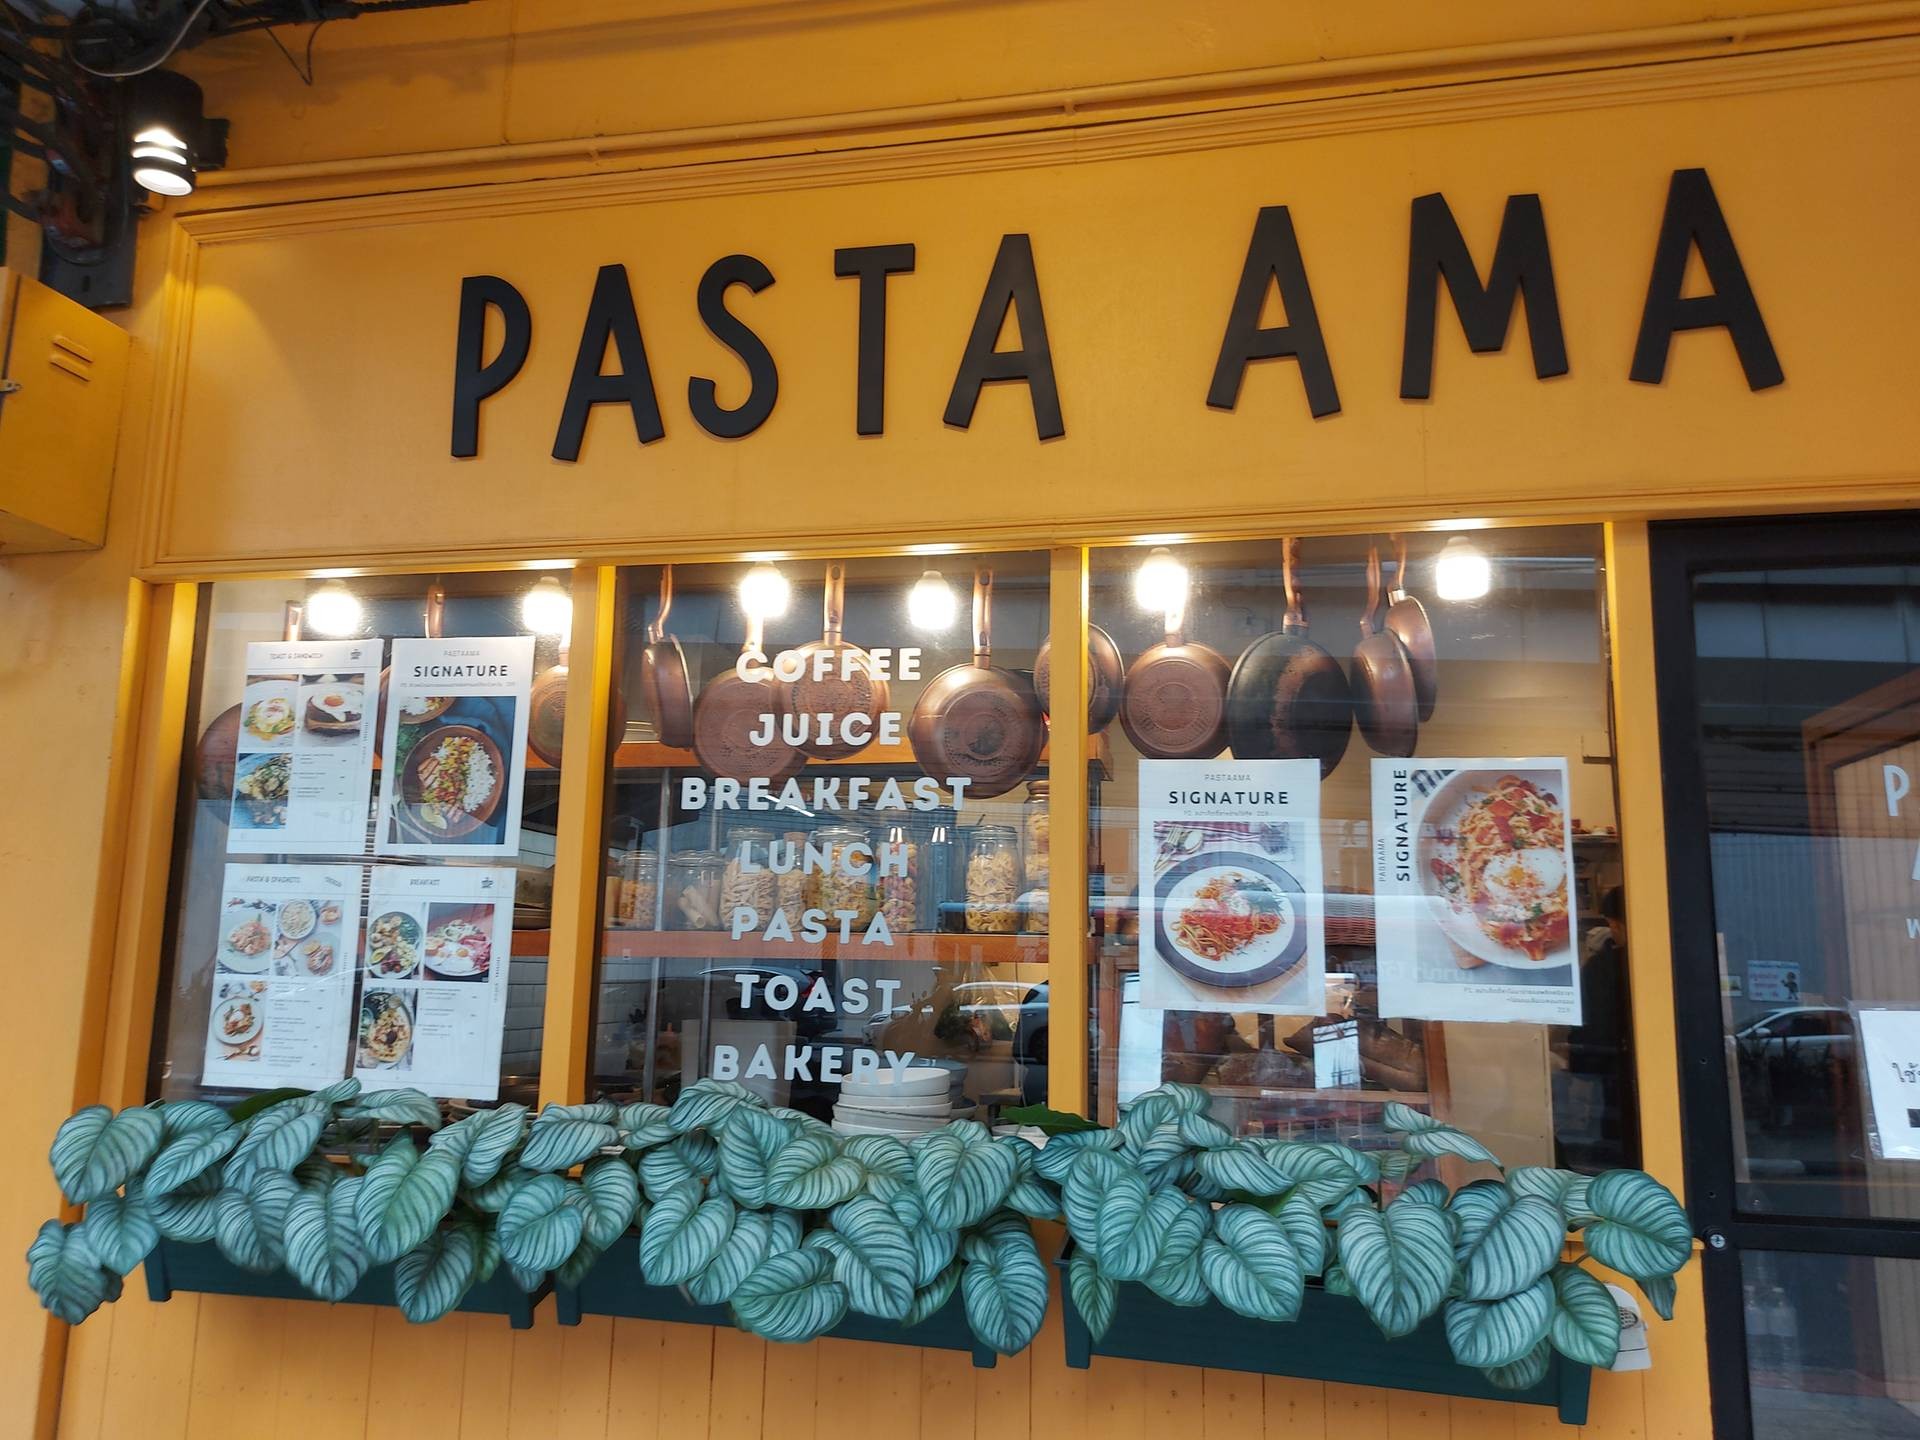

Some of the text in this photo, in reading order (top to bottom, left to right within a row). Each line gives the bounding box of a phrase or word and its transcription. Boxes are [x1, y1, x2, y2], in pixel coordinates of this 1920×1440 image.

[451, 168, 1785, 462] PASTA AMA
[413, 665, 509, 677] SIGNATURE
[736, 648, 922, 683] COFFEE
[749, 712, 902, 747] JUICE
[681, 776, 972, 811] BREAKFAST
[1168, 791, 1289, 805] SIGNATURE
[1393, 769, 1410, 882] SIGNATURE
[741, 841, 910, 878] LUNCH
[731, 906, 895, 946] PASTA
[734, 973, 902, 1017] TOAST
[713, 1044, 917, 1087] BAKERY
